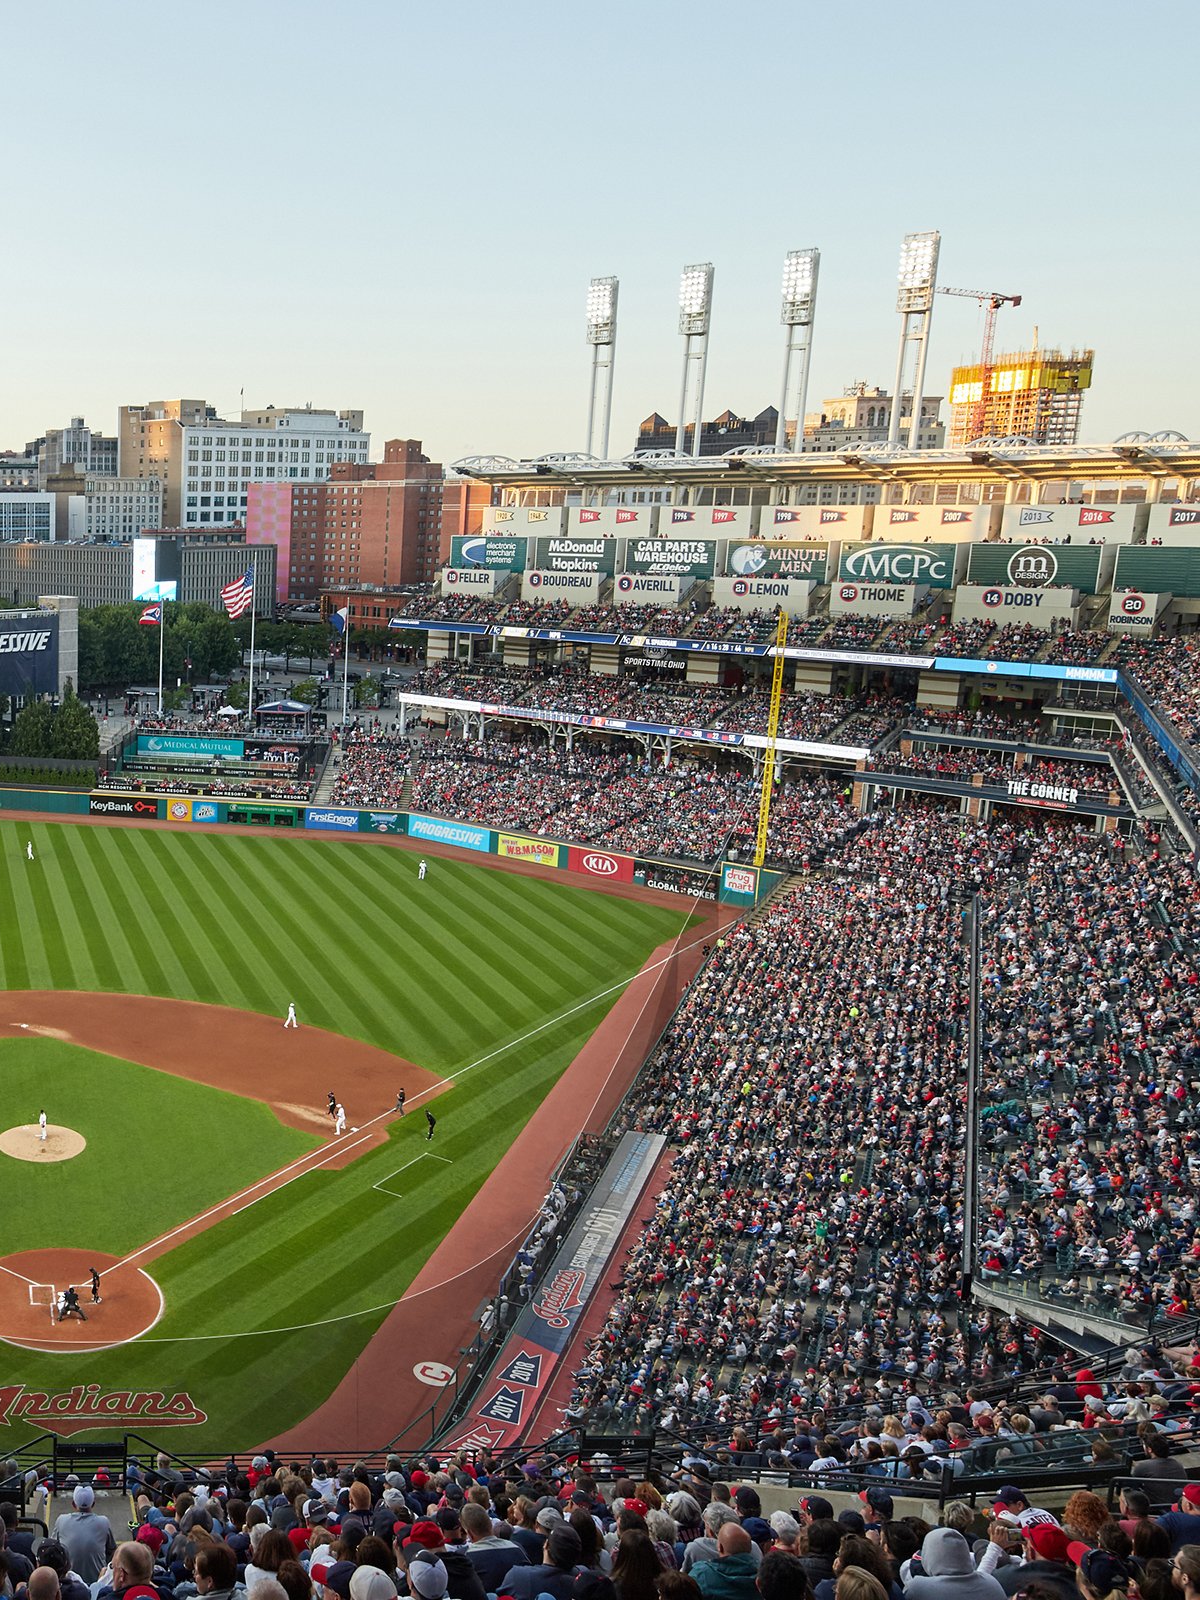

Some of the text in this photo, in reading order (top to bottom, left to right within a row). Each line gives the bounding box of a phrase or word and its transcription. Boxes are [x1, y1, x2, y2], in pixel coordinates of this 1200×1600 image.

[495, 510, 508, 520] 1920
[528, 510, 541, 520] 1948
[582, 511, 595, 521] 1954
[618, 511, 631, 521] 1995
[674, 511, 687, 521] 1996
[714, 511, 728, 521] 1997
[776, 511, 792, 521] 1998
[823, 511, 838, 521] 1999
[892, 511, 909, 521] 2001
[943, 511, 961, 521] 2007
[1023, 511, 1042, 521] 2013
[1083, 511, 1103, 521] 2016
[1174, 511, 1196, 522] 2017
[485, 542, 517, 550] electronic
[548, 539, 605, 553] McDonald
[638, 541, 706, 553] CAR PARTS
[485, 549, 516, 557] merchant
[634, 552, 708, 564] WAREHOUSE
[769, 548, 826, 562] MINUTE
[485, 556, 513, 565] systems
[552, 558, 598, 572] Hopkins
[779, 560, 812, 573] MEN
[1016, 556, 1048, 573] m
[648, 563, 692, 573] ACDelco
[459, 572, 490, 585] FELLER
[532, 575, 592, 588] 5 BOUDREAU
[621, 579, 675, 592] 3 AVERILL
[735, 582, 789, 597] 21 LEMON
[860, 587, 906, 602] THOME
[985, 592, 1044, 607] 14 DOBY
[1124, 600, 1142, 610] 20
[1110, 615, 1153, 625] ROBINSON
[668, 661, 685, 669] OHIO
[163, 740, 233, 752] MEDICAL MUTUAL
[1007, 780, 1078, 803] THE CORNER
[90, 800, 133, 812] KeyBank
[309, 811, 358, 827] FirstEnergy
[412, 820, 484, 846] PROGRESSIVE
[589, 858, 611, 870] KIA
[726, 868, 750, 884] drug
[647, 880, 716, 900] GLOBAL POKER
[728, 880, 754, 892] mart
[583, 1207, 621, 1234] 1901
[575, 1233, 601, 1269] ESTABLISHED
[532, 1269, 586, 1329] Indians
[510, 1360, 536, 1382] 2018
[490, 1394, 519, 1420] 2017
